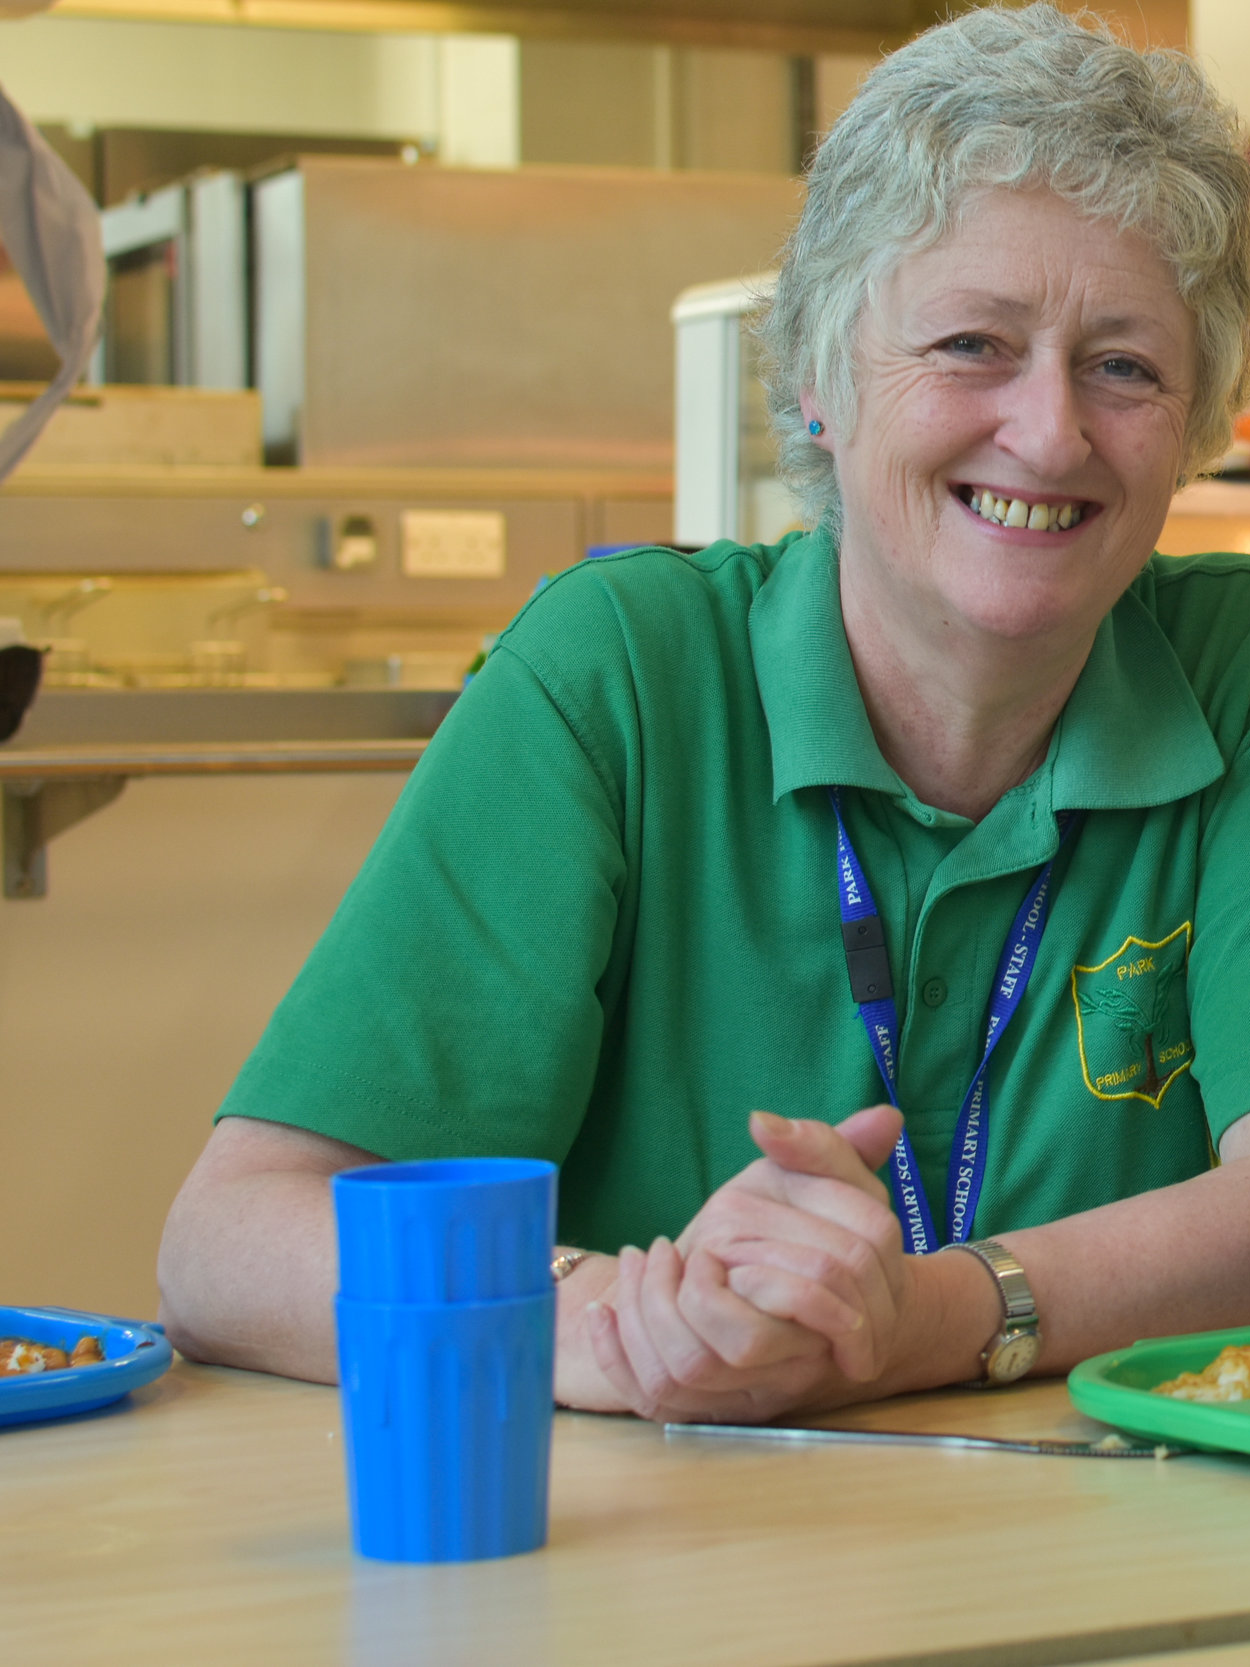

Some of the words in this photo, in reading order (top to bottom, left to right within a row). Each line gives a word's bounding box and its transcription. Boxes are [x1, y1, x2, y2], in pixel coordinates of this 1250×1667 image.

[841, 855, 862, 905] PARK
[1000, 943, 1029, 999] STAFF
[1116, 957, 1156, 981] PARK
[1095, 1063, 1142, 1091] PRIMARY
[962, 1080, 984, 1165] PRIMARY
[952, 1166, 974, 1242] SCHOOL
